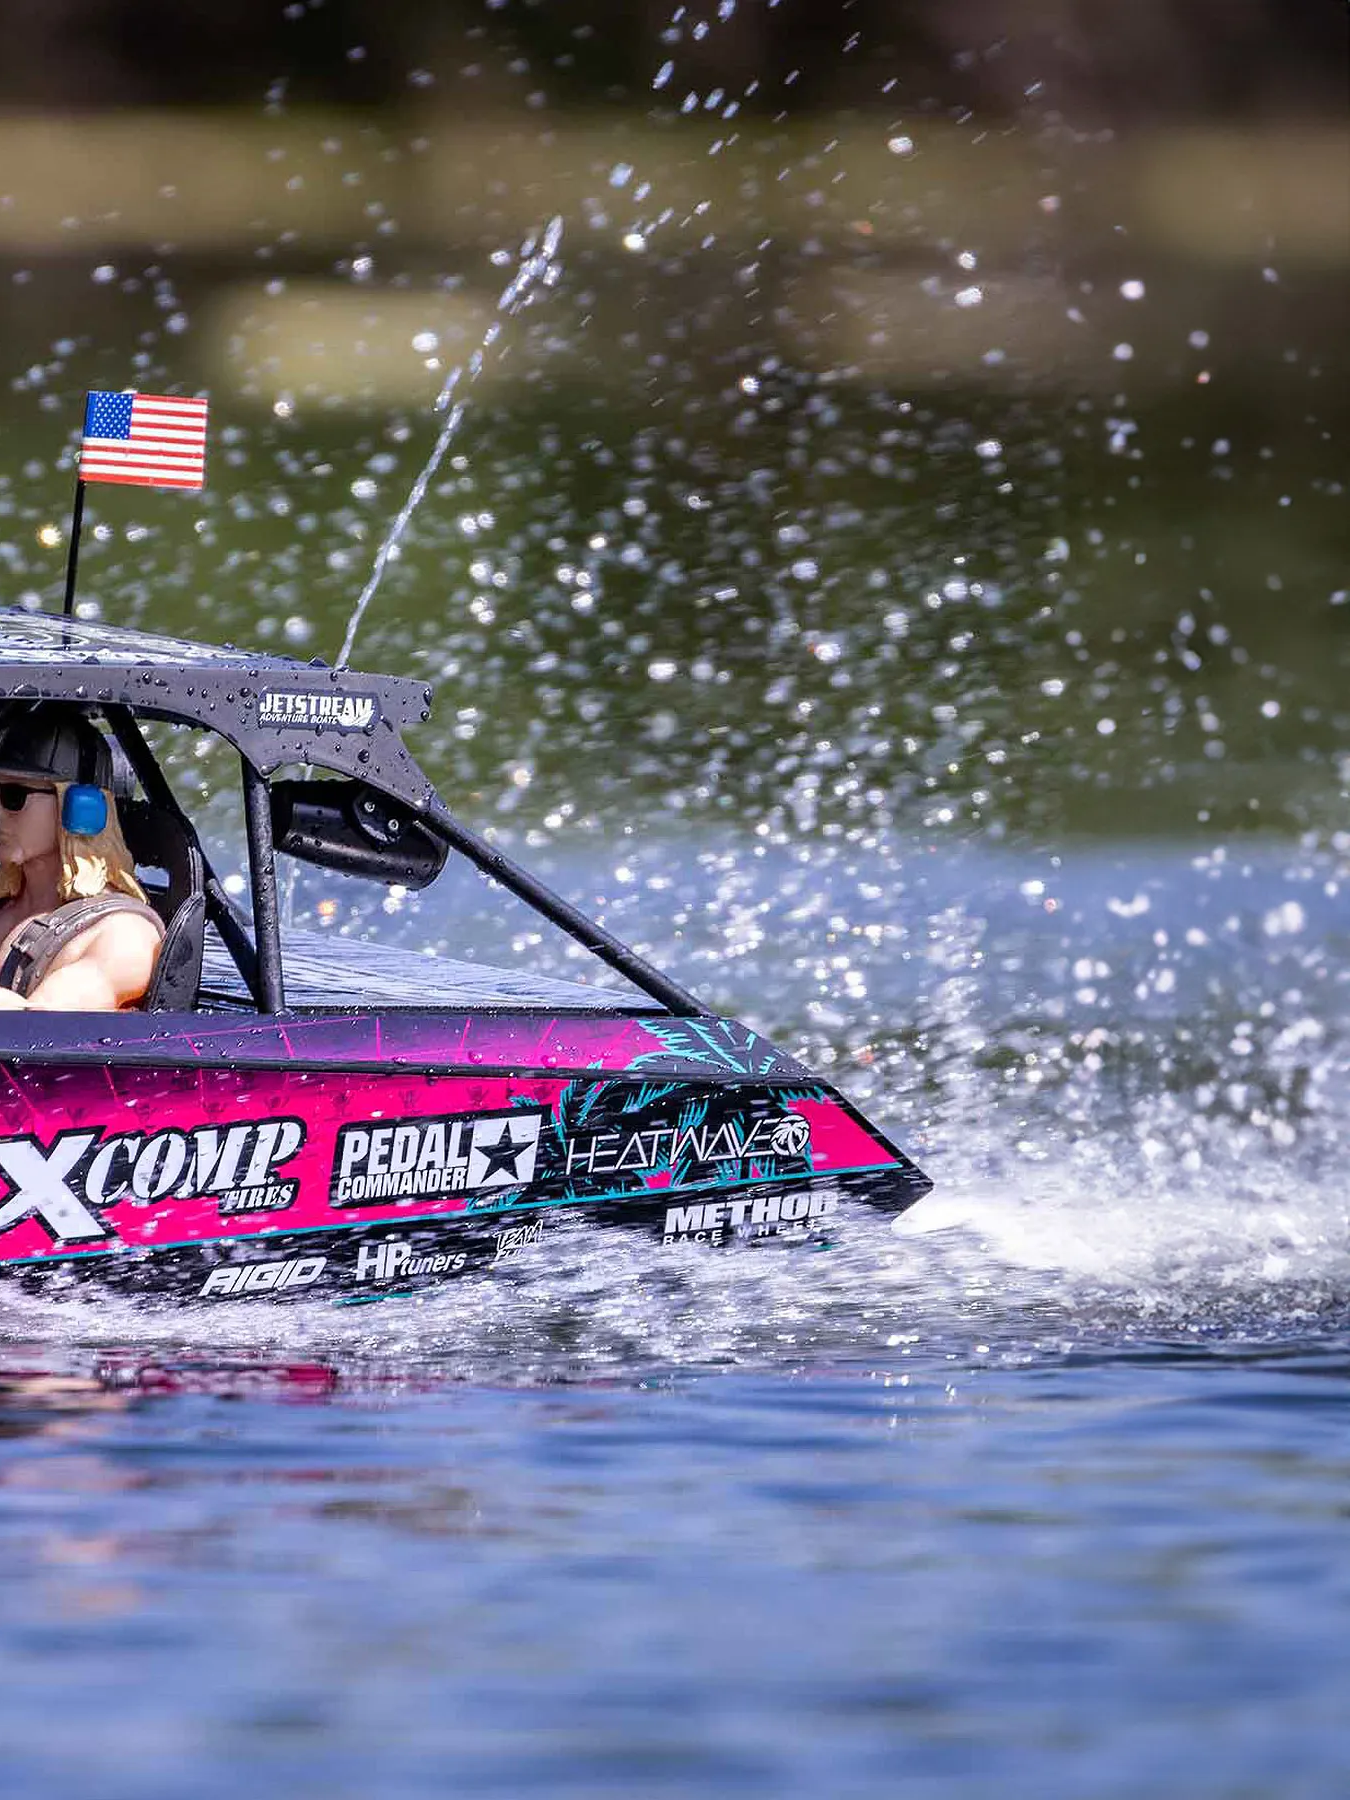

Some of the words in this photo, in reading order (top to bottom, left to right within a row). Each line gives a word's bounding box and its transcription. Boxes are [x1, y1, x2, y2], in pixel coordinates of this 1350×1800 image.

[259, 693, 373, 719] JETSTREAM
[260, 713, 309, 724] ADVENTURE
[339, 1121, 470, 1178] PEDAL
[224, 1184, 294, 1210] TIRES
[337, 1167, 468, 1201] COMMANDER
[663, 1190, 841, 1233] METHOD
[653, 1229, 724, 1246] RACE
[198, 1257, 327, 1296] RIGID
